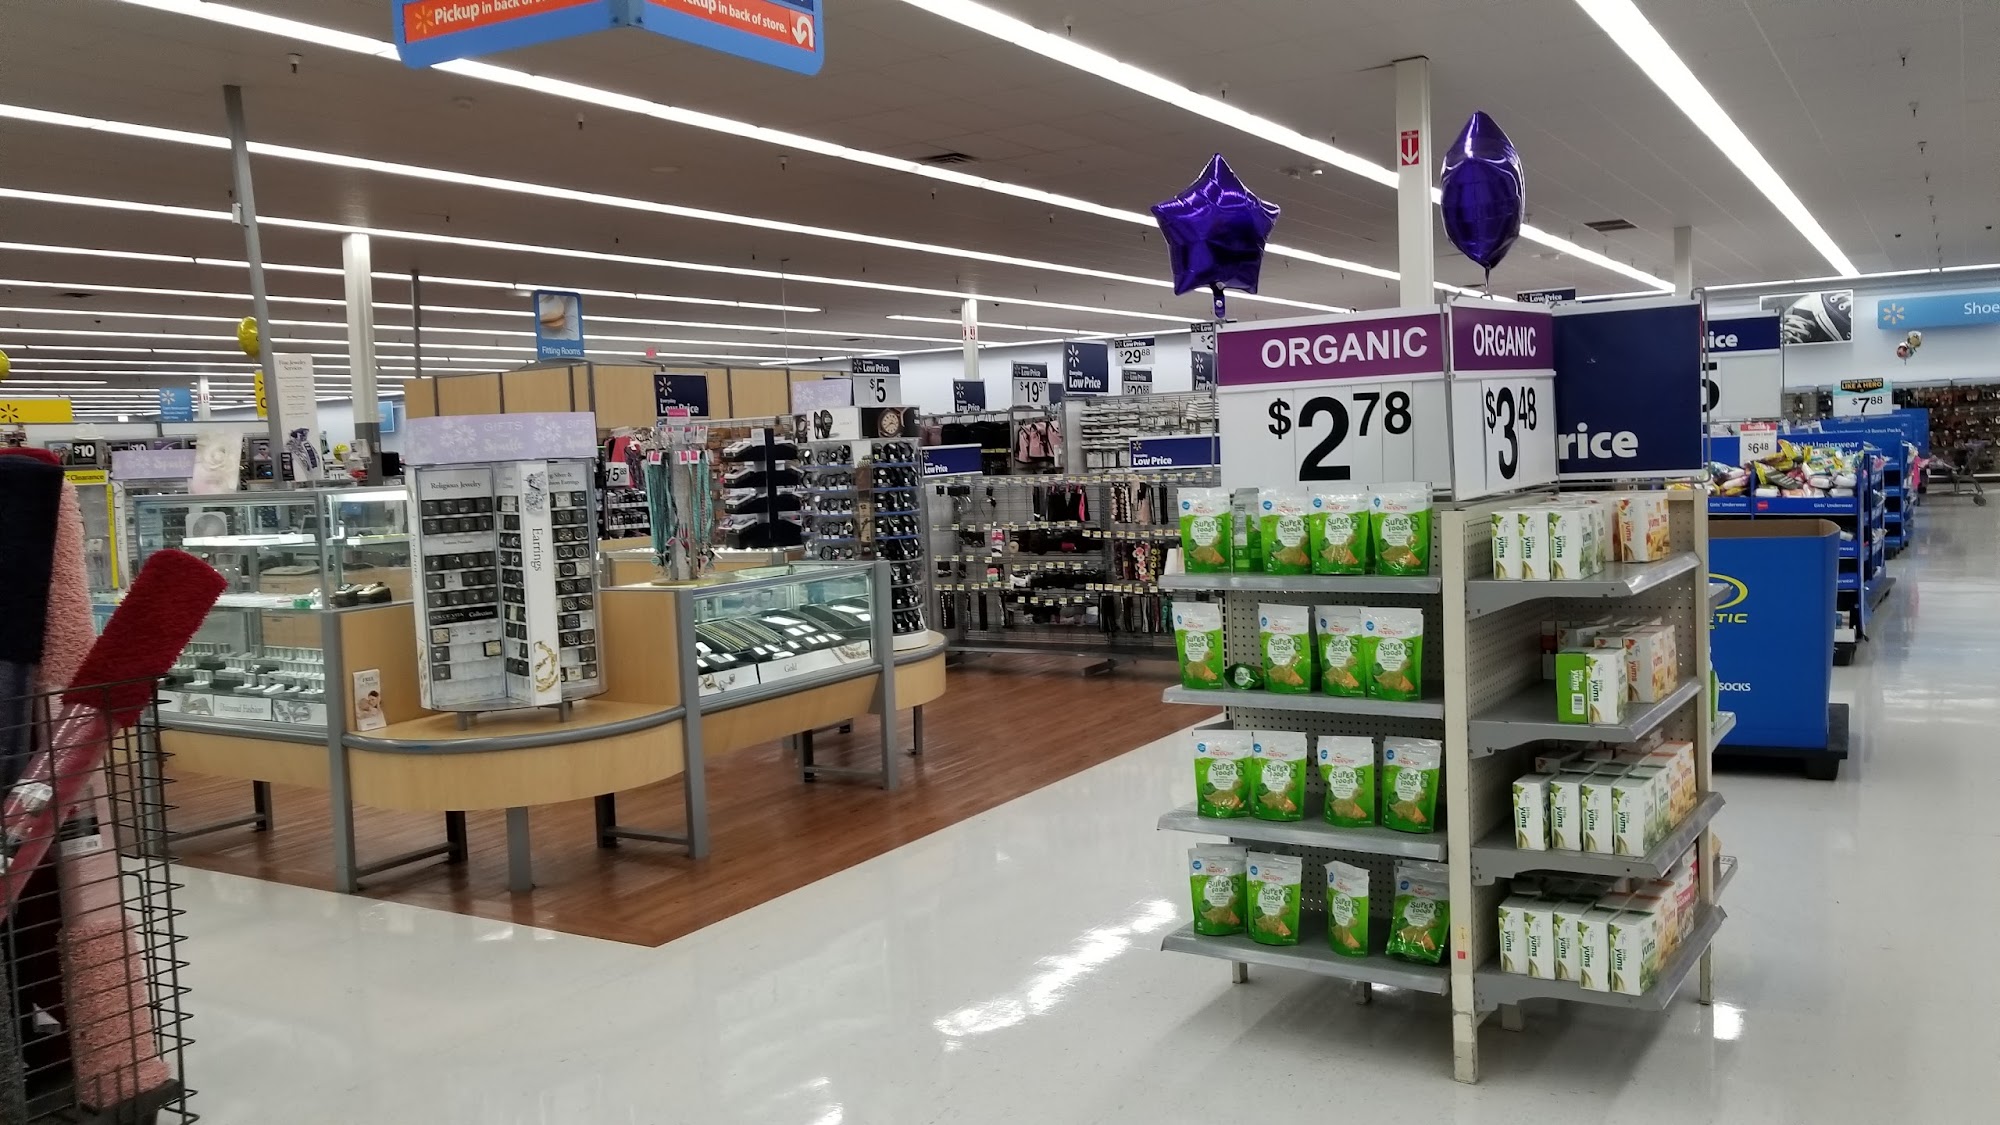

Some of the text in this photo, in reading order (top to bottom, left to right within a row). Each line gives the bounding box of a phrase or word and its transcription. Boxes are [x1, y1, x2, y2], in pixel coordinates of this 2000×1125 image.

[435, 3, 479, 25] Pickup
[482, 3, 492, 15] in
[718, 2, 728, 15] in
[729, 7, 751, 23] back
[752, 14, 762, 26] of
[1473, 323, 1537, 357] ORGANIC
[542, 346, 581, 358] Fitting Rooms
[1261, 326, 1428, 369] ORGANIC
[863, 363, 890, 373] Low Price
[1069, 376, 1101, 389] Low Price
[870, 378, 886, 403] $5
[679, 403, 699, 414] Pice
[1558, 422, 1639, 460] rice
[1813, 441, 1859, 449] Underwear
[74, 445, 95, 457] $10
[1133, 456, 1172, 466] Low Price
[924, 464, 948, 474] Low Price
[530, 528, 544, 572] Earrings
[784, 663, 798, 673] Gold
[1719, 682, 1751, 692] SOCKS
